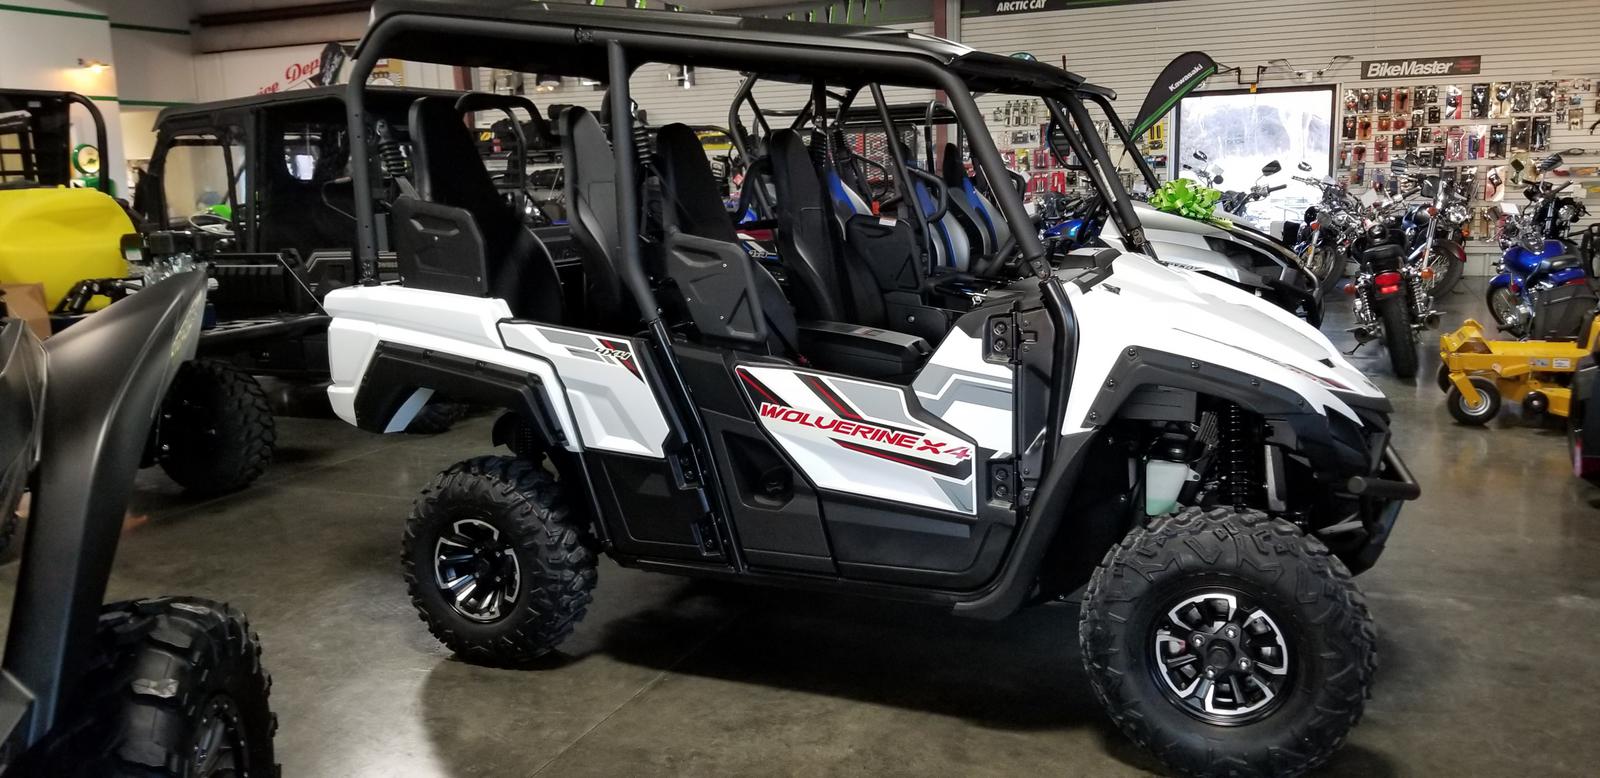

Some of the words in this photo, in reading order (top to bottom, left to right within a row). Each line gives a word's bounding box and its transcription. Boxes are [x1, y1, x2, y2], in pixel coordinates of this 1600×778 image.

[996, 0, 1029, 12] ARCTIC
[1030, 0, 1047, 9] CAT
[1168, 63, 1204, 92] Kawasaki
[1367, 61, 1454, 77] BikeMaster
[760, 404, 917, 449] WOLVERINE
